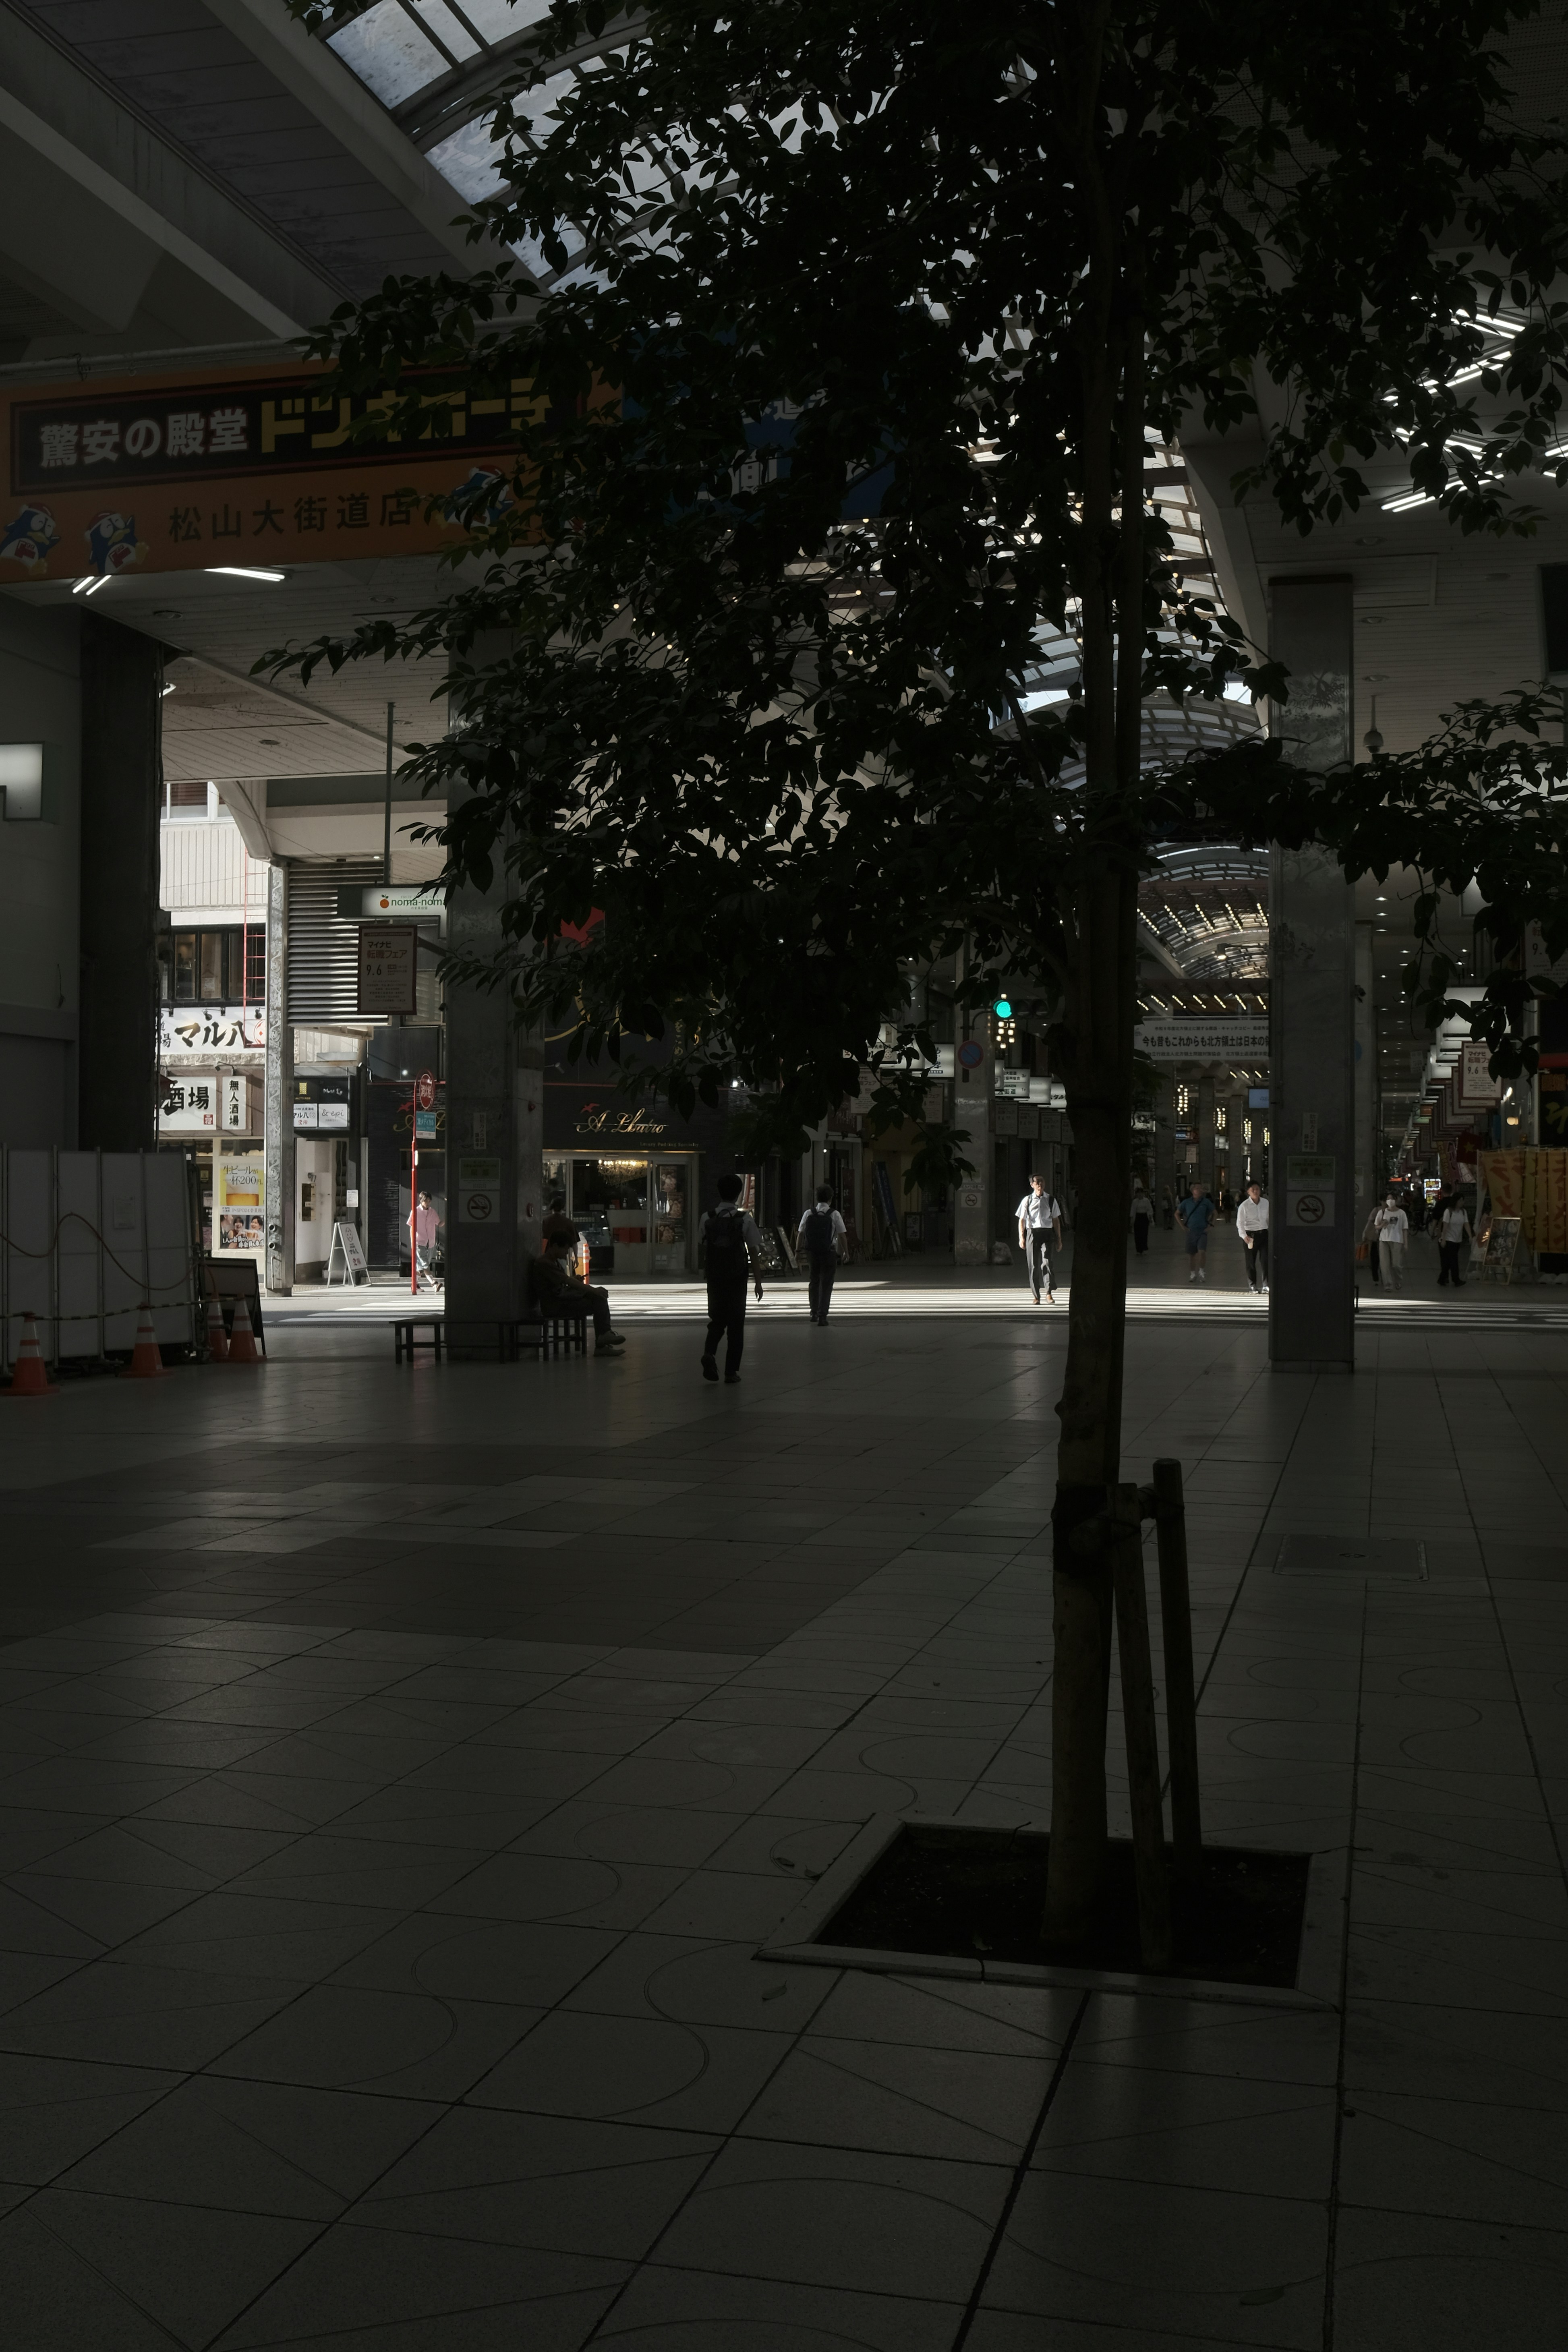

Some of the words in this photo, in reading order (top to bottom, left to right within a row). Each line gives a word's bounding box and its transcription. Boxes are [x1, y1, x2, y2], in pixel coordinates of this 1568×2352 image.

[39, 406, 248, 468] 驚安の殿堂
[169, 489, 412, 544] 松山大街道店
[367, 950, 407, 959] 転職フェア
[367, 964, 381, 975] 9.6
[174, 1020, 253, 1048] マル八
[1467, 1066, 1479, 1075] 9.6
[421, 1084, 432, 1098] 消火栓
[229, 1080, 240, 1126] 無人酒場
[223, 1165, 259, 1175] 生ビールが
